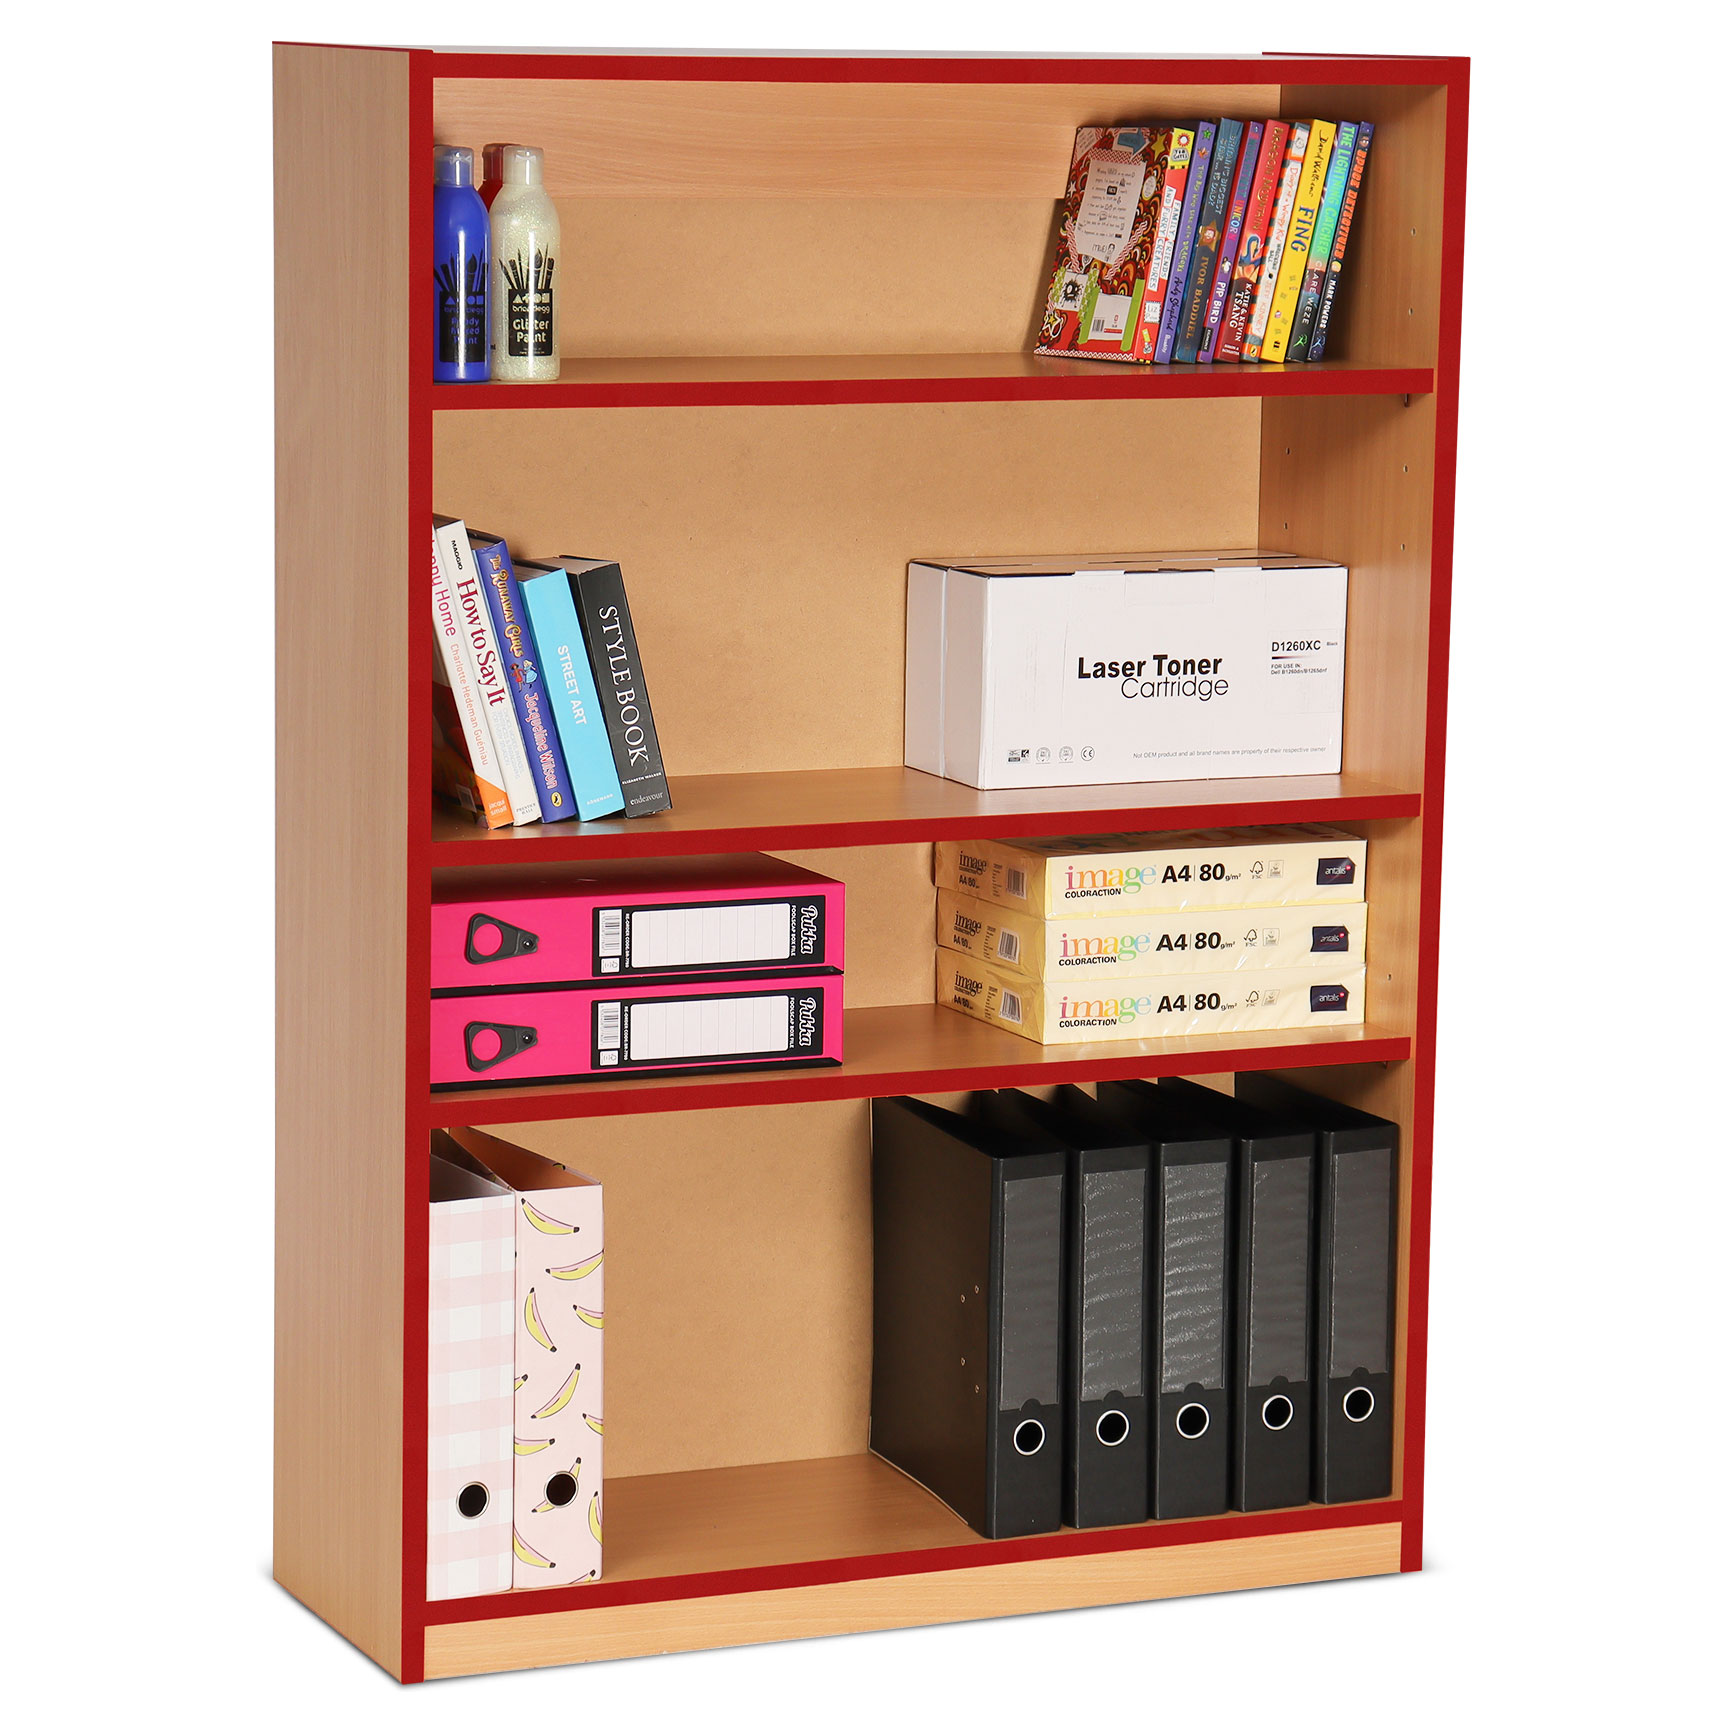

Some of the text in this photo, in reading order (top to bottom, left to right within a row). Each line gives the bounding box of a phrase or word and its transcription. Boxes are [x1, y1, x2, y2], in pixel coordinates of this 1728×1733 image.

[1287, 167, 1299, 189] Diary
[1319, 126, 1355, 254] THE LIGHTNING CATCHER
[1215, 178, 1227, 214] BIGGEST
[1149, 187, 1174, 288] AND FURRY CREATURES
[1291, 205, 1315, 252] FING
[1161, 241, 1174, 279] FRIENDS
[1186, 256, 1209, 339] IVOR BADDIEL
[1210, 281, 1226, 324] PIP BIRD
[1244, 283, 1253, 308] KATIE
[1302, 260, 1322, 325] CLARE WEZE
[1319, 279, 1336, 329] MARK POWERS
[452, 317, 480, 326] Rady
[1230, 292, 1244, 328] TSANG
[1256, 302, 1267, 333] KINNEY
[451, 327, 480, 335] Mxed
[512, 319, 549, 331] Gliter
[517, 331, 546, 343] Pant
[1235, 315, 1246, 342] KEVIN
[454, 336, 478, 344] Pint
[451, 540, 463, 570] MAGGIO
[490, 569, 516, 623] RUNAWAY
[435, 588, 456, 637] Home
[457, 578, 505, 707] How to Say It
[1272, 640, 1321, 652] D1260XC
[1078, 654, 1223, 679] Laser Toner
[450, 643, 467, 684] Charlotte
[462, 685, 478, 729] Hedeman
[557, 645, 587, 726] STREET ART
[599, 605, 650, 767] STYLE BOOK
[1121, 676, 1229, 702] Cartridge
[524, 692, 558, 789] Jacqueline Wilson
[1157, 751, 1177, 759] product
[1241, 748, 1263, 756] property
[1282, 747, 1309, 755] respective
[630, 792, 663, 806] endeavour
[959, 850, 987, 875] image
[1161, 865, 1191, 883] A4
[1199, 863, 1225, 881] 80
[1325, 865, 1347, 875] antalis
[1065, 865, 1156, 894] image
[1065, 888, 1121, 899] COLORACTION
[801, 904, 818, 954] Pukka
[954, 910, 982, 936] image
[1060, 933, 1151, 961] image
[1156, 933, 1188, 951] A4
[1194, 931, 1221, 949] 80
[1059, 956, 1117, 966] COLORACTION
[954, 970, 983, 997] image
[1059, 996, 1151, 1024] image
[1157, 995, 1187, 1013] A4
[1194, 993, 1221, 1010] 80
[1319, 993, 1340, 1002] antalis
[799, 997, 816, 1046] Pukka
[1059, 1018, 1117, 1028] COLORACTION
